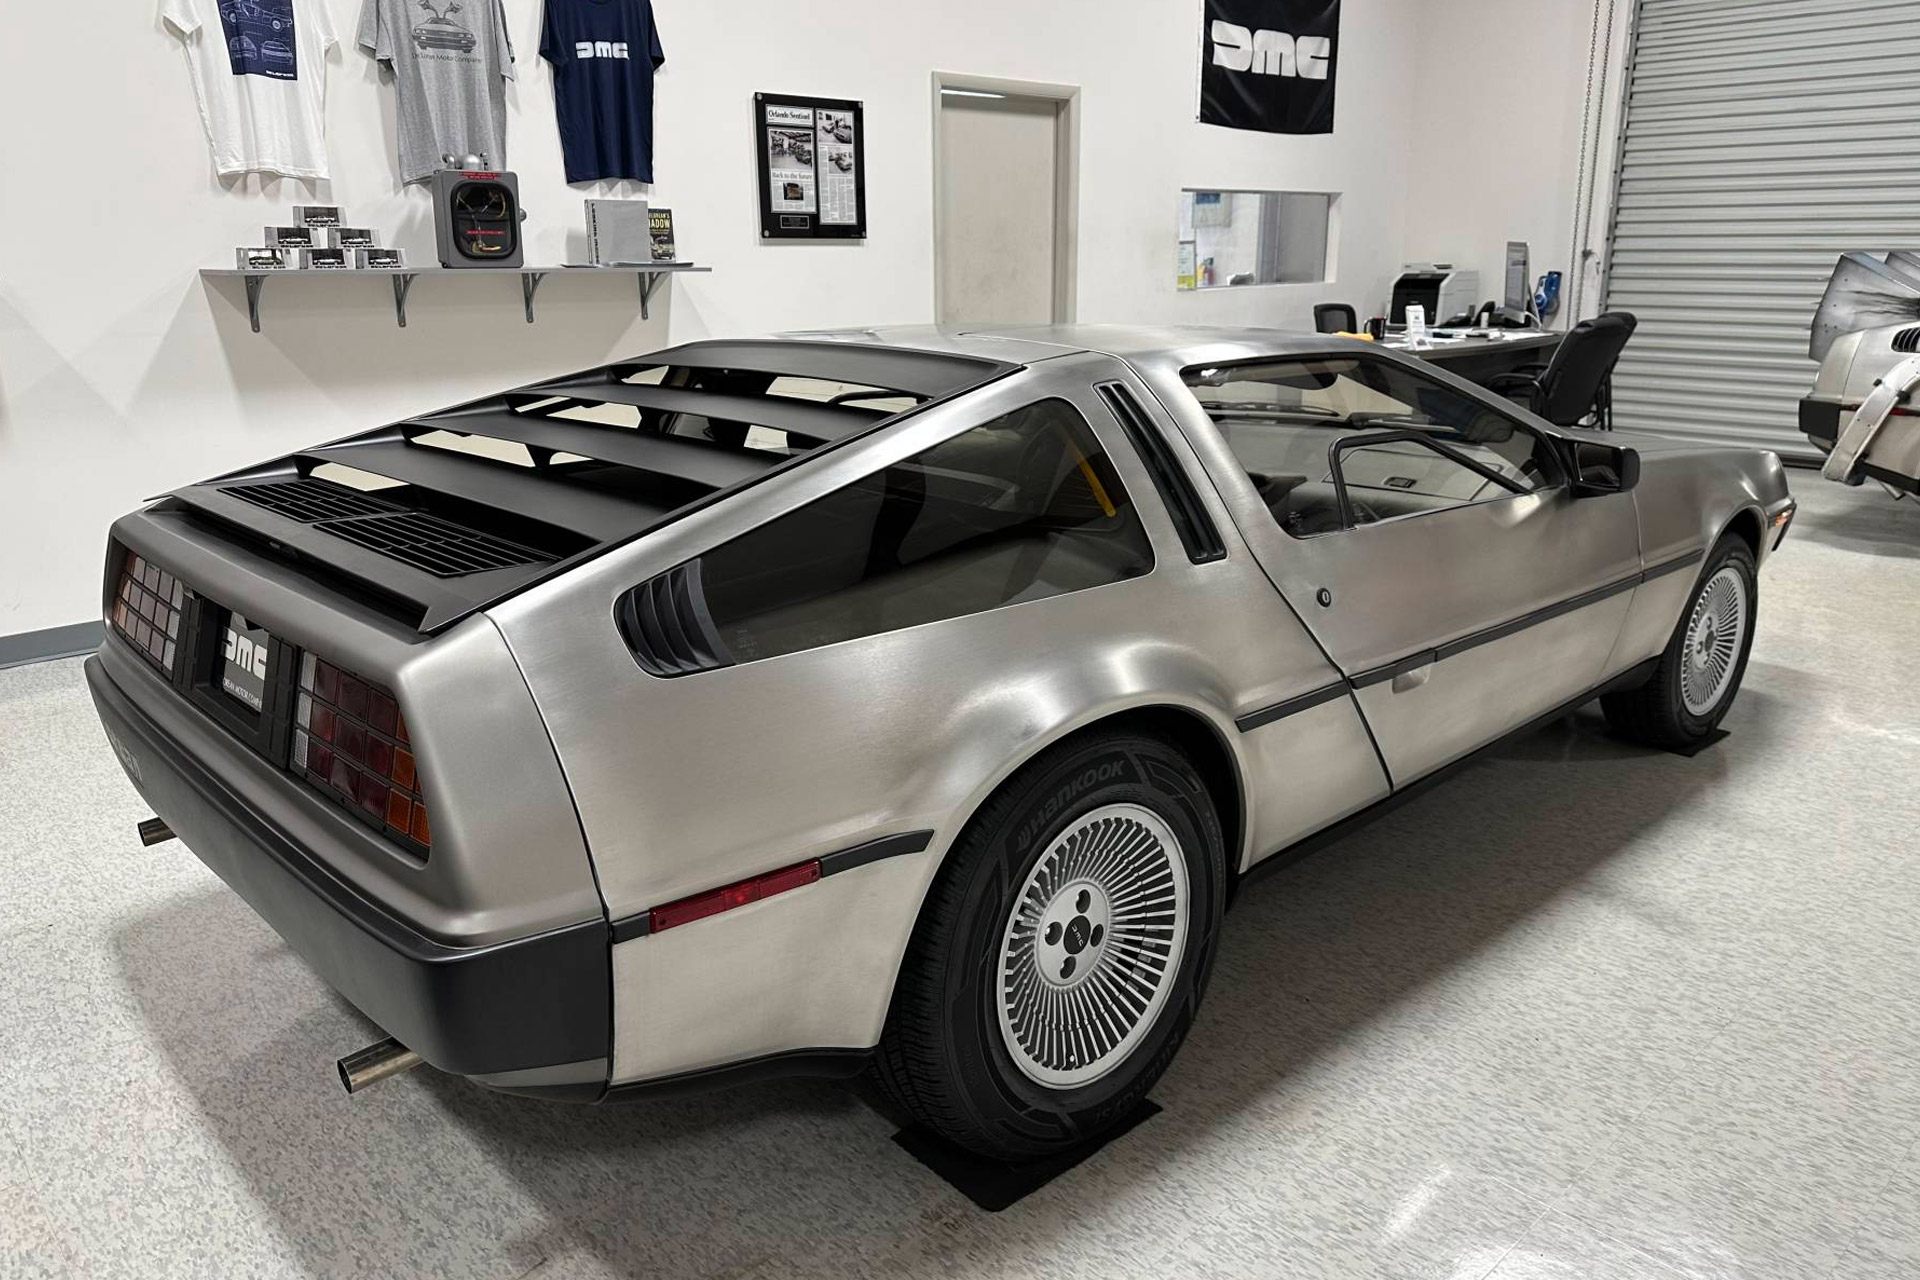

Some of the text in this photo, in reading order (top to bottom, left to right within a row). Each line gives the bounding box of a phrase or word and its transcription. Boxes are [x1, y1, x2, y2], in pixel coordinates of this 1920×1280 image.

[768, 109, 811, 120] Orlando Sentinel
[772, 171, 783, 179] Back
[648, 218, 670, 229] ADOW
